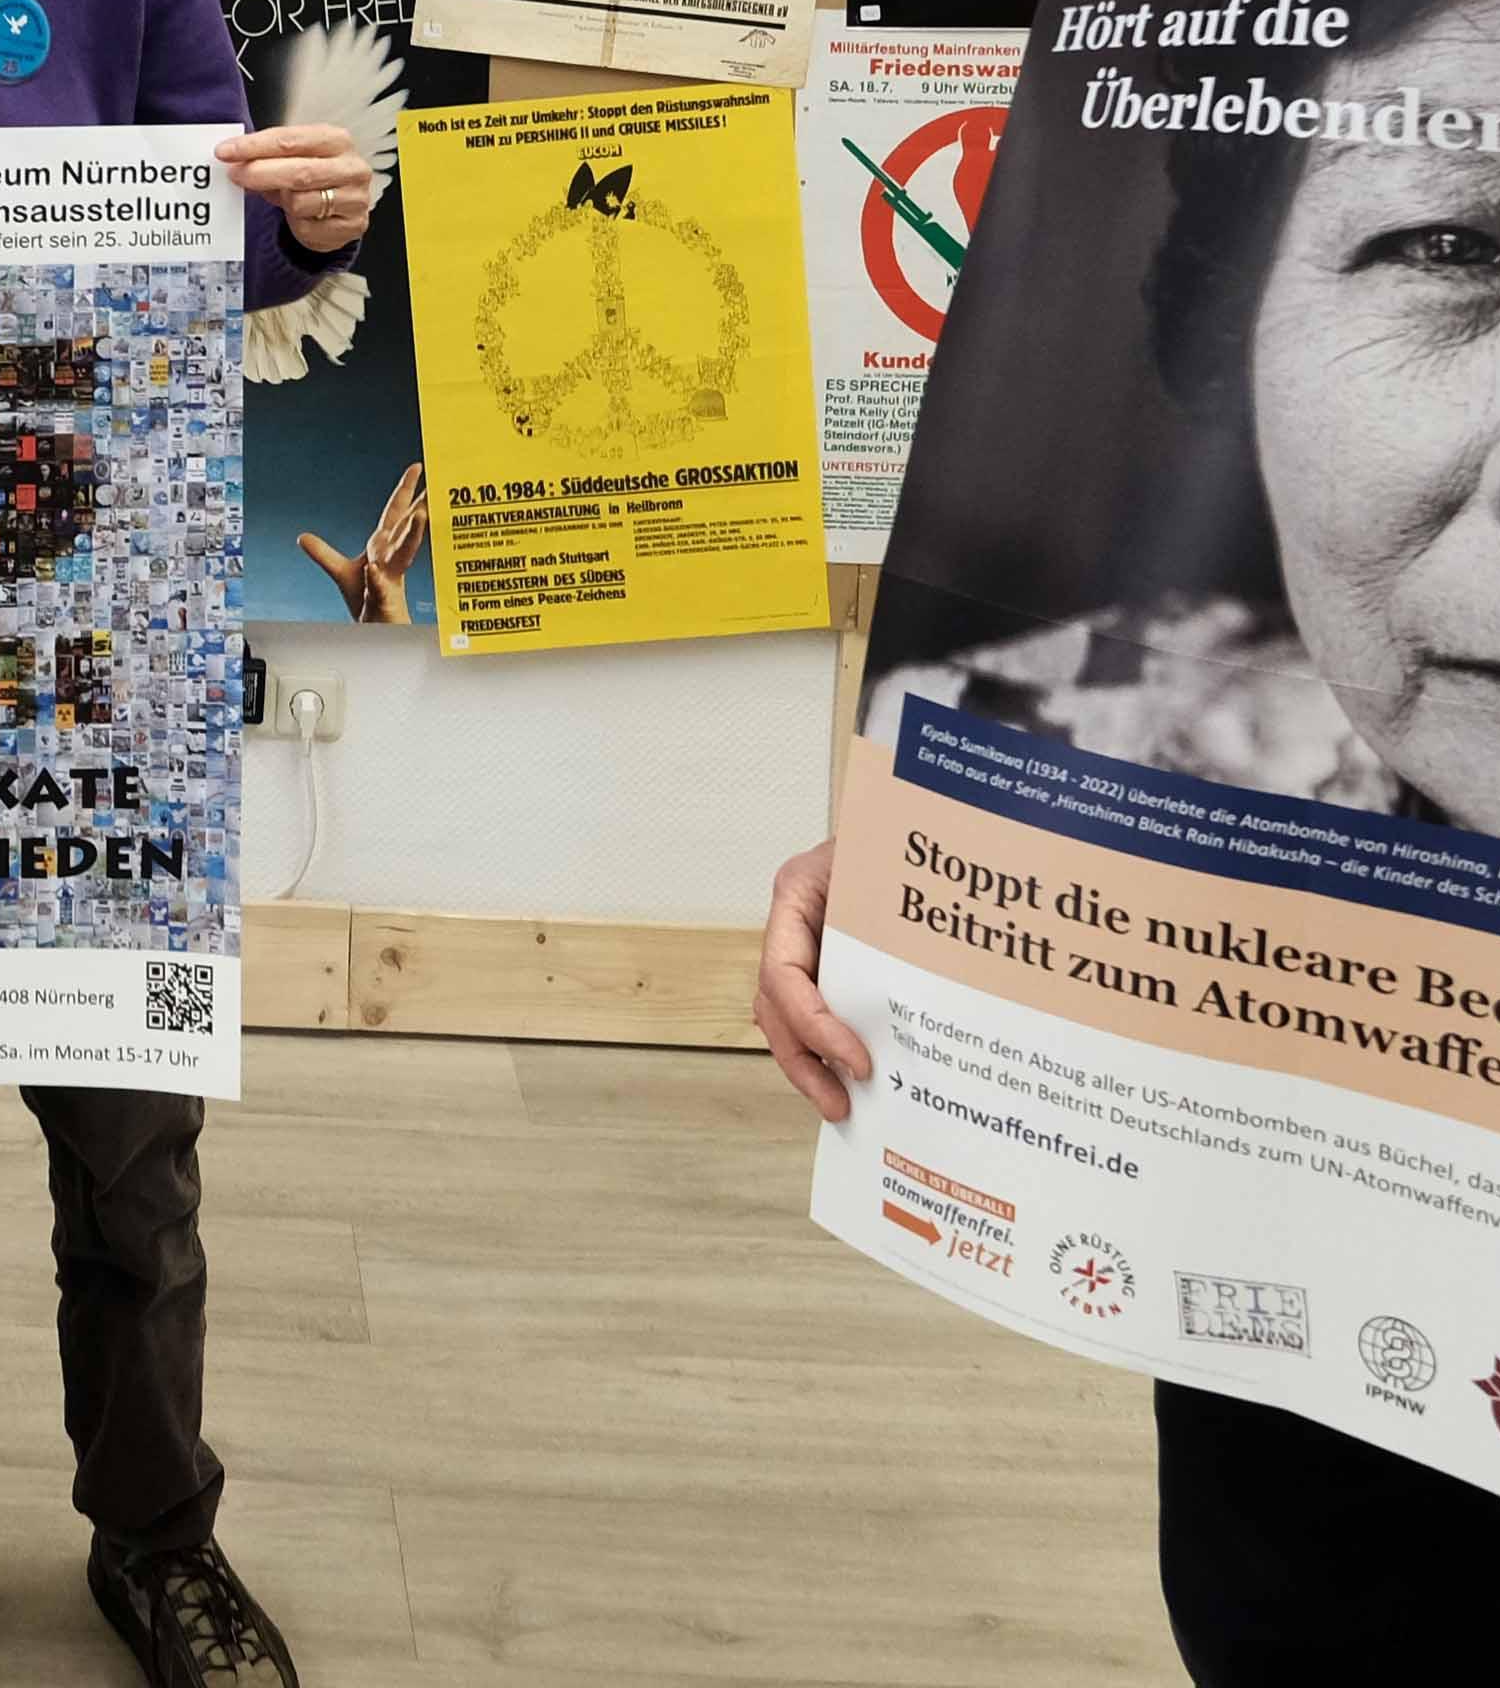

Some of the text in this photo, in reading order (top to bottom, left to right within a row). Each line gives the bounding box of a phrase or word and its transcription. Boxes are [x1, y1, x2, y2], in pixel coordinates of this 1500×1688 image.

[830, 40, 1022, 57] Militärfestung Mainfranken
[1052, 1, 1155, 56] Hört
[62, 159, 212, 192] Nürnberg
[50, 230, 89, 250] sein
[94, 231, 122, 250] 25.
[128, 227, 212, 249] Jubiläum
[560, 461, 799, 498] Süddeutsche GROSSAKTION
[460, 613, 542, 632] FRIEDENSFEST
[903, 829, 1044, 918] Stoppt
[1053, 875, 1135, 939] die
[1146, 911, 1399, 998] nukleare
[896, 882, 1058, 977] Beitritt
[1067, 943, 1179, 1009] zum
[887, 997, 1328, 1144] Wir fordern den Abzug aller US-Atombomben
[909, 1082, 1140, 1180] atomwaffenfrei.de
[945, 1230, 1015, 1278] jetzt
[1364, 1381, 1429, 1417] IPPNW
